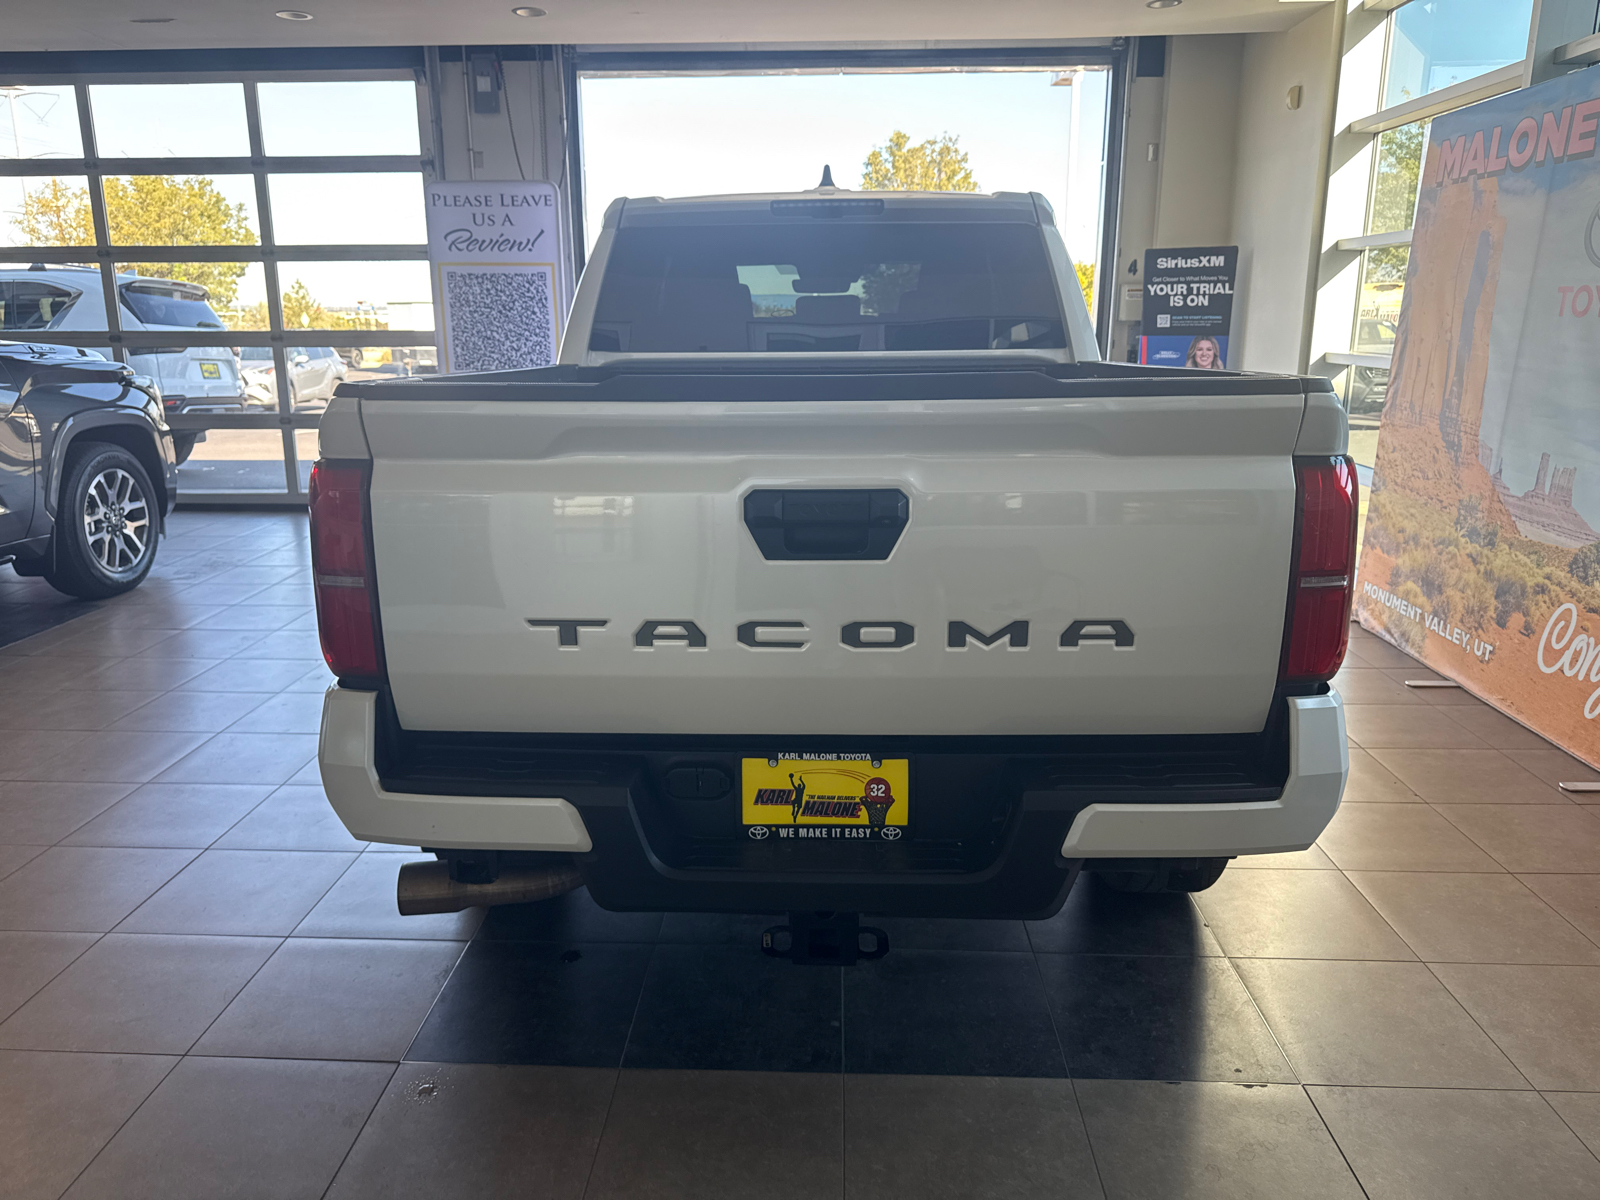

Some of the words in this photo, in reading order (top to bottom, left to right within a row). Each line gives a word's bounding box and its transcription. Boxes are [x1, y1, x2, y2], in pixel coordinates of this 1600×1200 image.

[1436, 97, 1600, 187] MALONE
[431, 193, 493, 207] PLEASE
[500, 193, 553, 207] LEAVE
[502, 213, 515, 227] A
[443, 228, 545, 252] Review!
[1128, 259, 1138, 276] 4
[1157, 255, 1225, 269] SiriusXM
[1147, 283, 1188, 296] YOUR
[1190, 282, 1234, 294] TRIAL
[1169, 295, 1184, 307] IS
[1186, 295, 1209, 307] ON
[1557, 284, 1600, 319] TO
[1363, 581, 1422, 623] MONUMENT
[1424, 611, 1471, 654] VALLEY,
[1473, 638, 1494, 661] UT
[524, 618, 1136, 652] TACOMA
[1537, 602, 1600, 719] Con
[778, 752, 800, 760] KARL
[802, 753, 838, 761] MALONE
[839, 753, 871, 761] TOYOTA
[753, 788, 795, 806] KARL
[870, 784, 886, 797] 32
[801, 800, 862, 818] MALONE
[779, 828, 795, 838] WE
[799, 828, 828, 838] MAKE
[832, 828, 842, 838] IT
[845, 828, 871, 838] EASY
